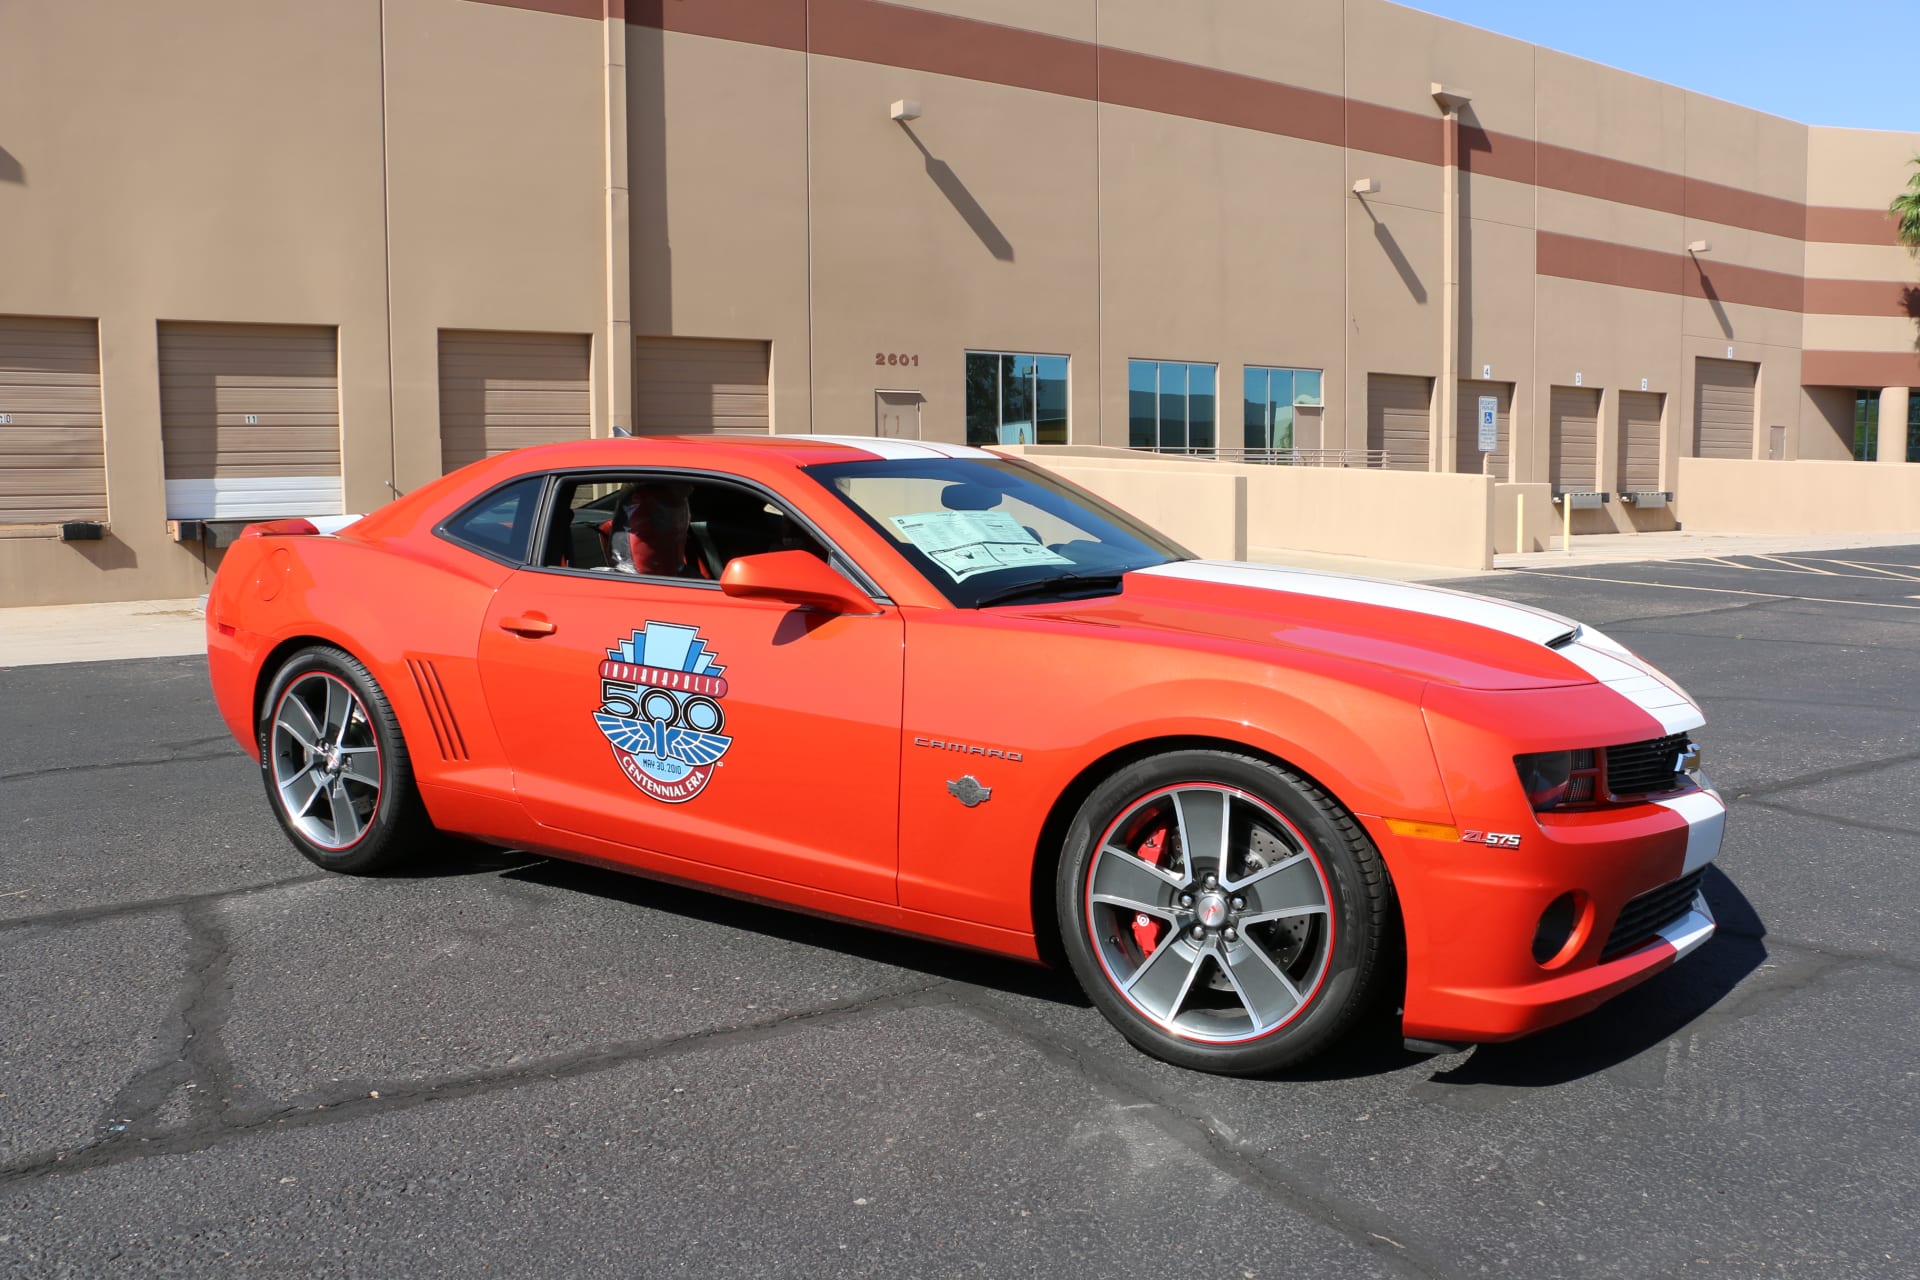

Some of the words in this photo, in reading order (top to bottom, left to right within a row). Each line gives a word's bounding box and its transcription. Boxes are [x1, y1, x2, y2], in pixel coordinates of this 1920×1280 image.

[875, 352, 919, 367] 2601
[604, 662, 720, 695] INDIANAPOLIS
[599, 678, 726, 735] 500
[914, 736, 1023, 762] CAMARO
[622, 756, 687, 797] CENTENNIAL
[686, 770, 705, 792] ERA
[642, 758, 656, 769] MAY
[667, 763, 682, 775] 2010
